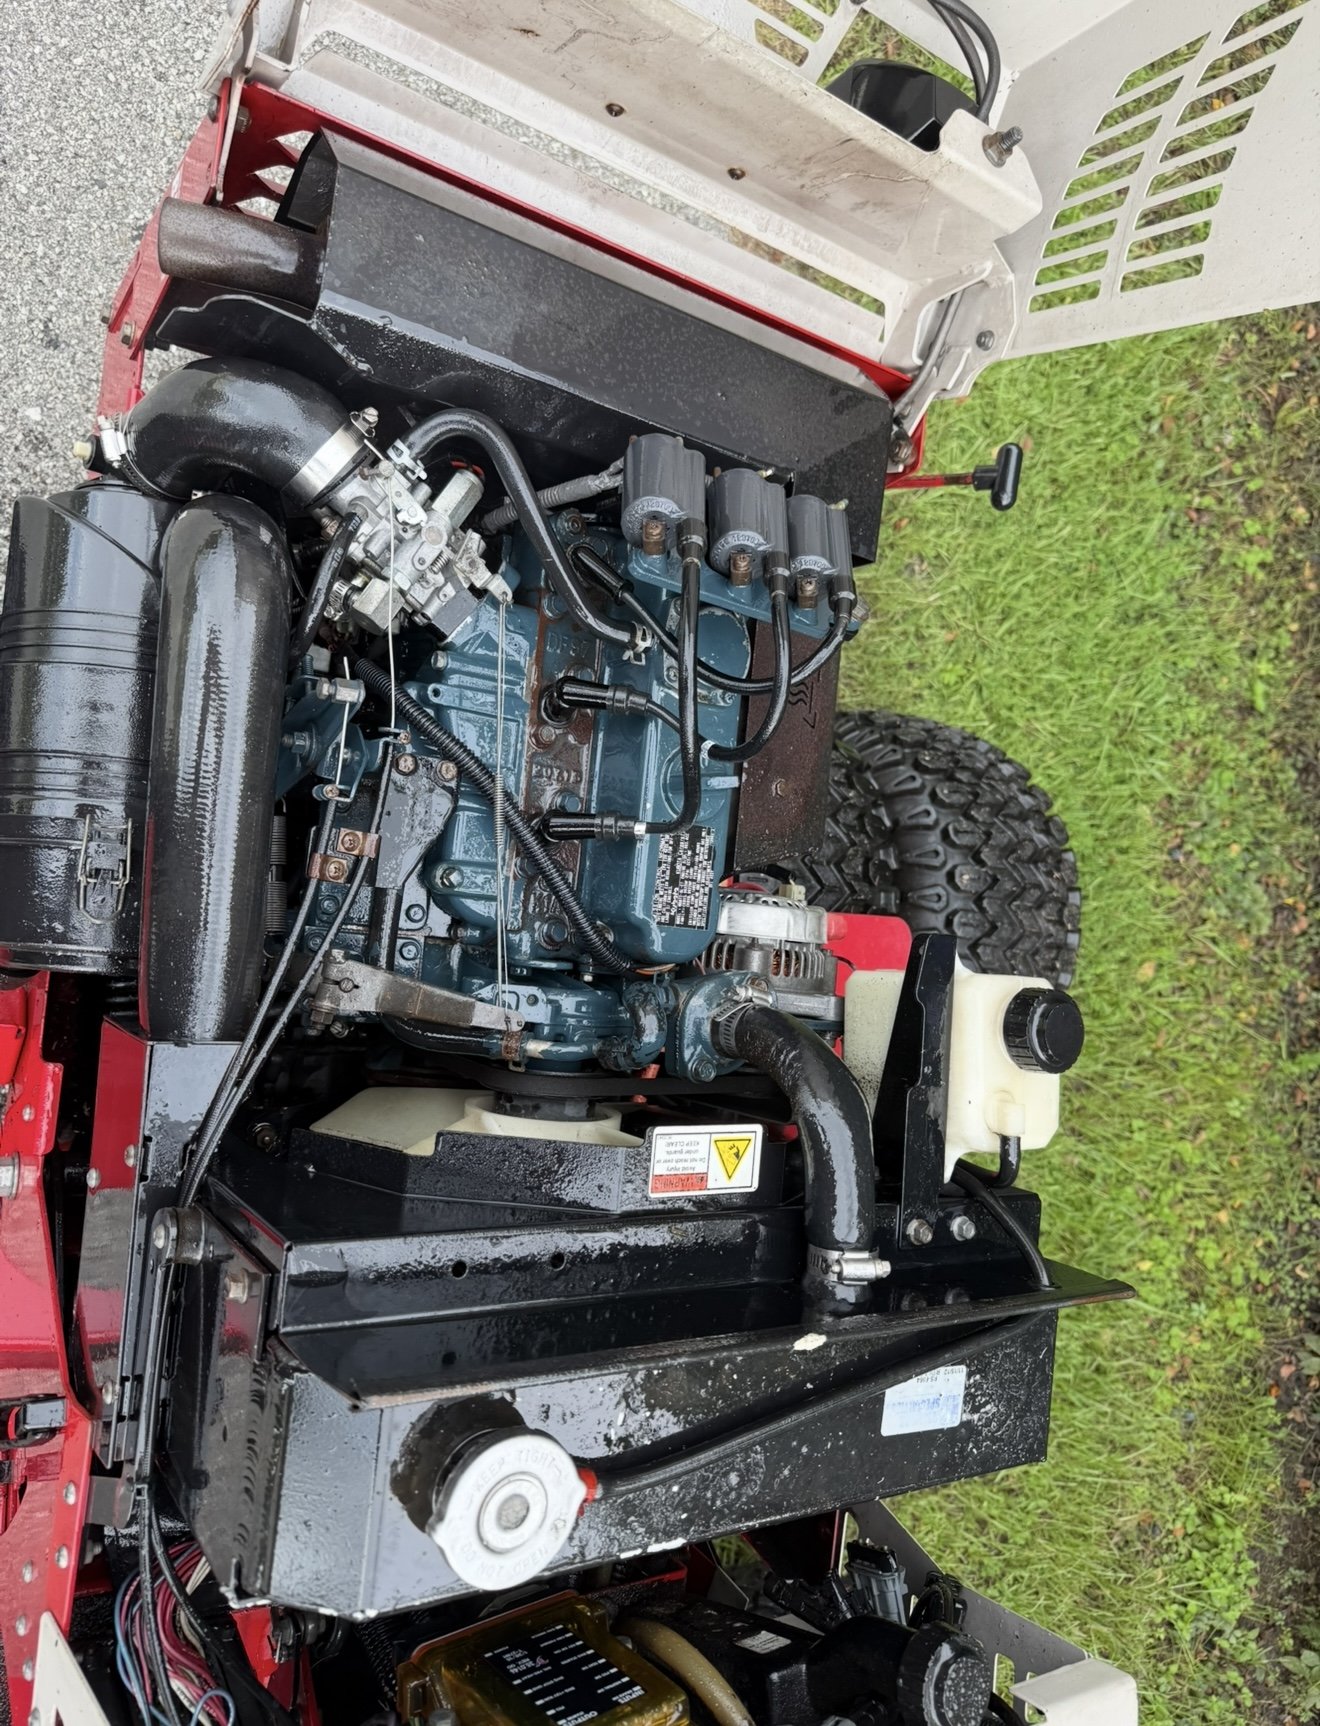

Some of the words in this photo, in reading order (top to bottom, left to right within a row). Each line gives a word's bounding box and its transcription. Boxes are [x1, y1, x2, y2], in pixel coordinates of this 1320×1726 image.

[472, 1456, 505, 1493] KEEP
[518, 1449, 556, 1468] TIGHT
[477, 1561, 504, 1578] NOT
[513, 1544, 549, 1576] OPEN
